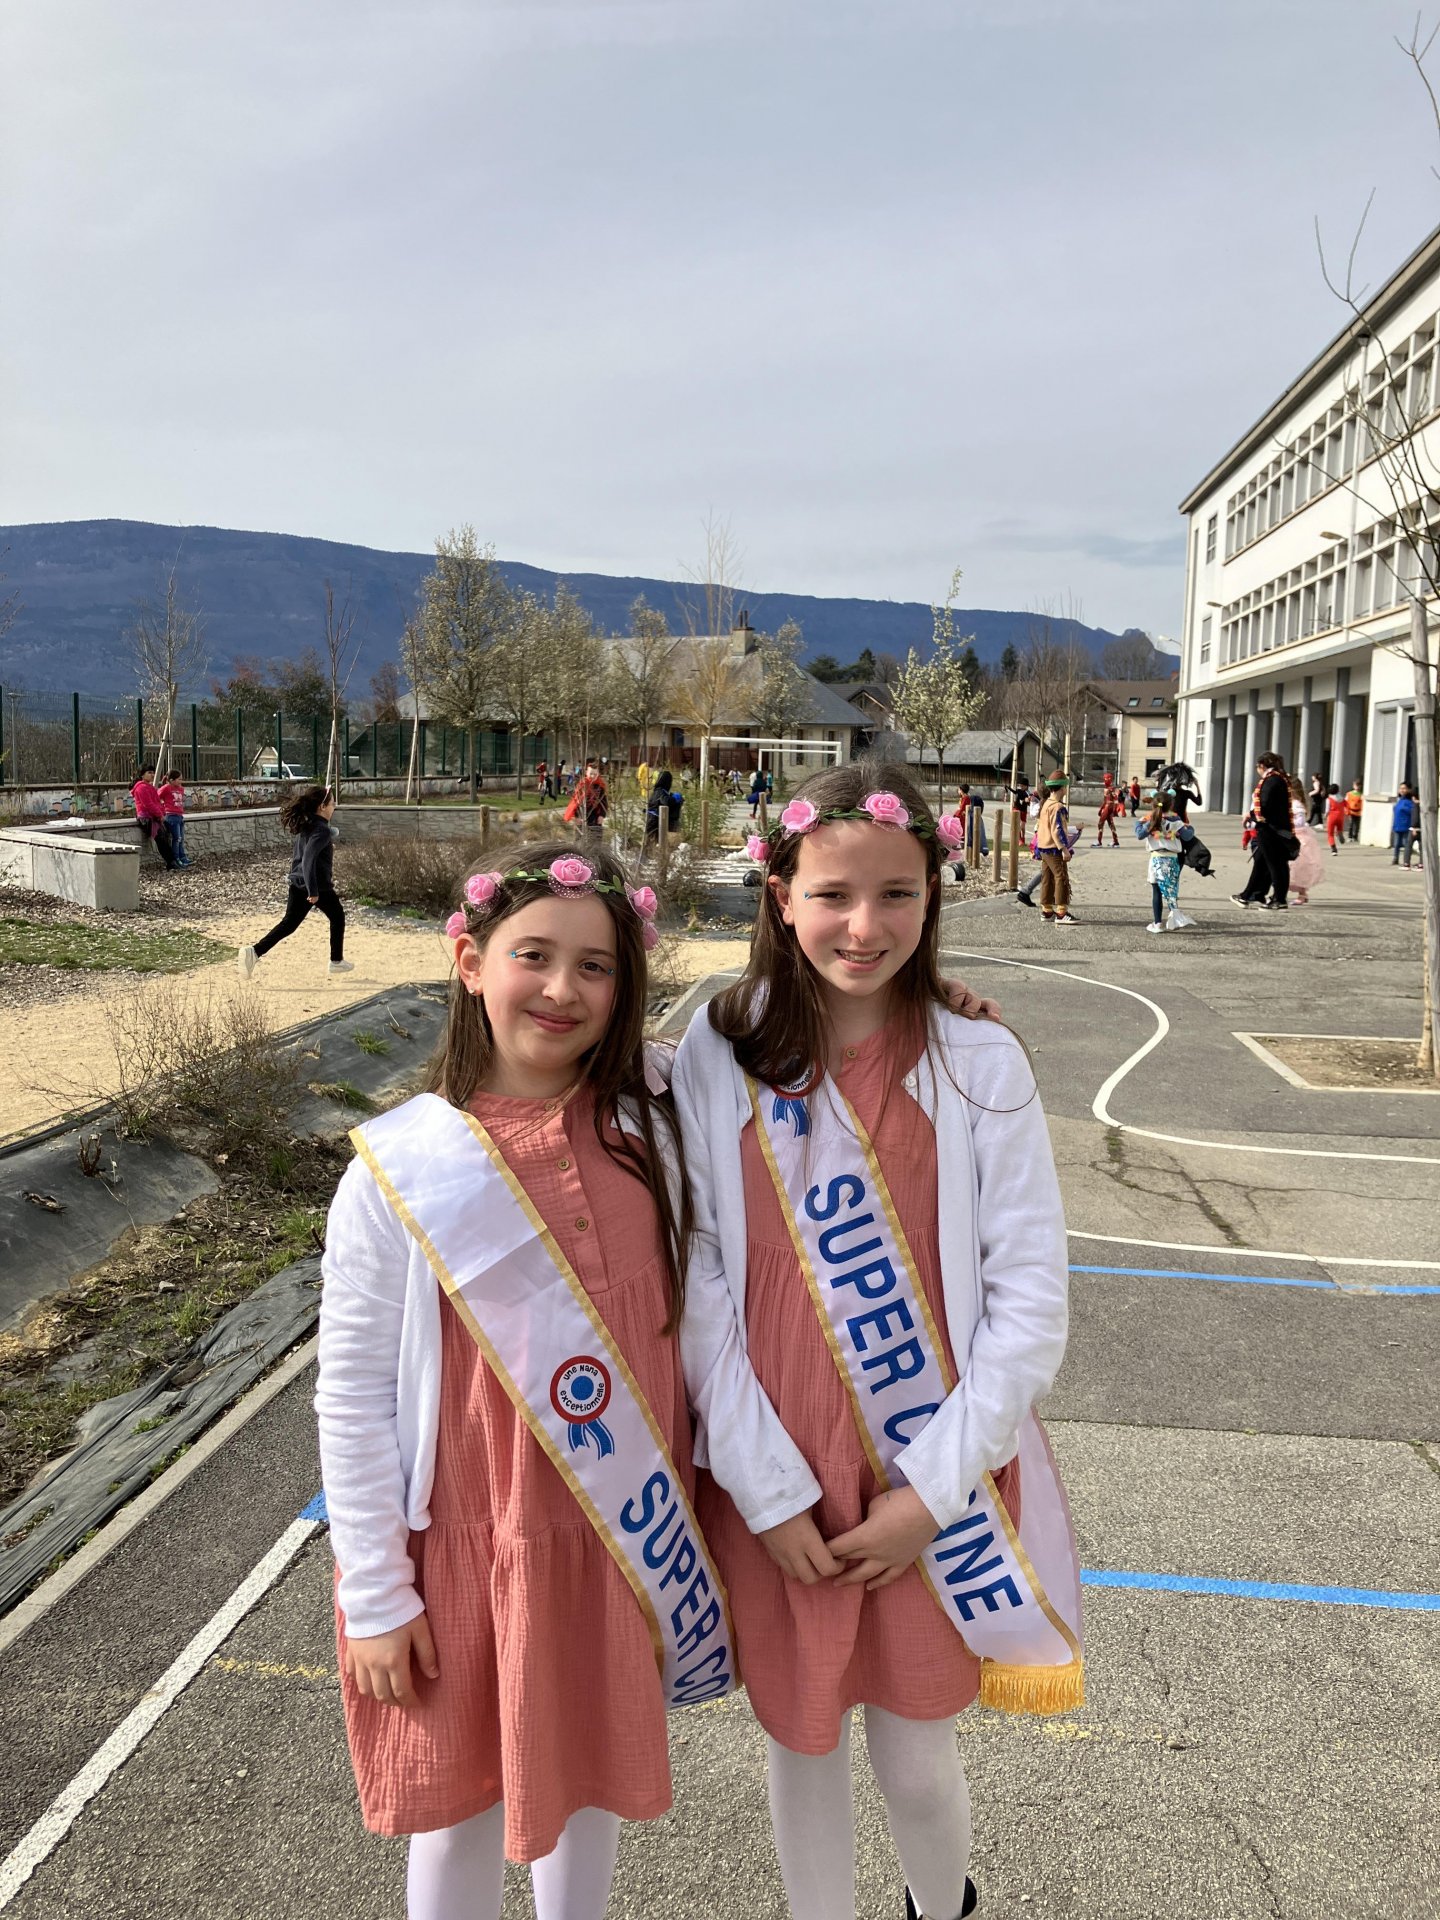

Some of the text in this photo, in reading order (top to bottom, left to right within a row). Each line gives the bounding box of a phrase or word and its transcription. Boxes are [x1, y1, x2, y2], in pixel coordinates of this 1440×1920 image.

[560, 1382, 605, 1412] exceptionnelle
[804, 1174, 1024, 1622] SUPER CINE
[619, 1471, 721, 1662] SUPER
